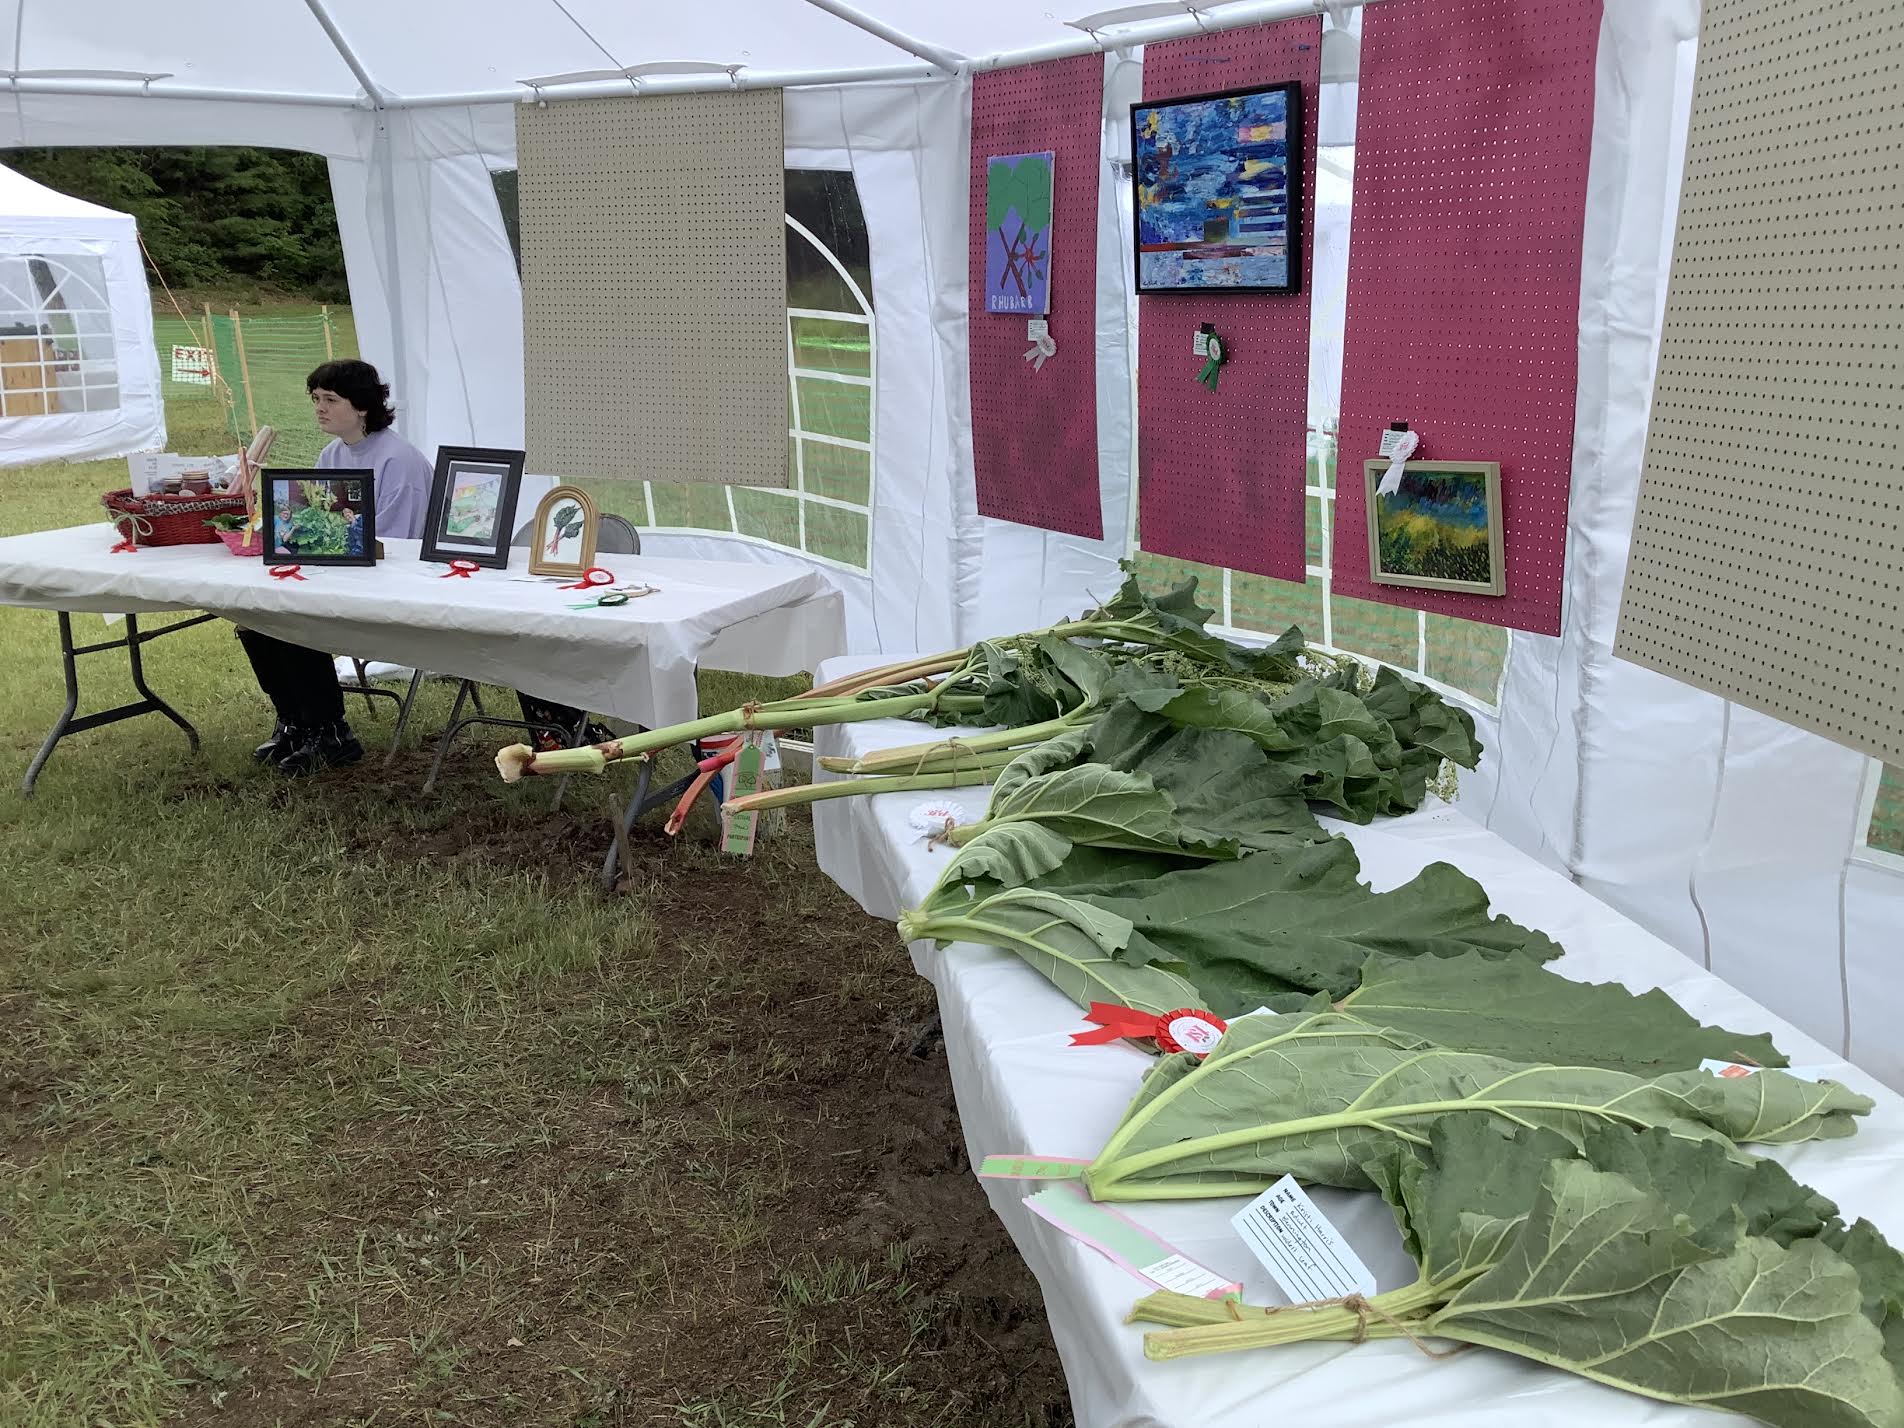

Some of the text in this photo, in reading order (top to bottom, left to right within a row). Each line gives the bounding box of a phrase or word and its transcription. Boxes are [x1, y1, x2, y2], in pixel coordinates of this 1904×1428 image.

[991, 295, 1033, 310] RHUBARB
[175, 348, 208, 362] EXI
[1275, 1194, 1285, 1204] AGE
[1283, 1188, 1296, 1203] NAME
[1268, 1199, 1281, 1213] TOWN
[1260, 1205, 1284, 1234] DESCRIPTION
